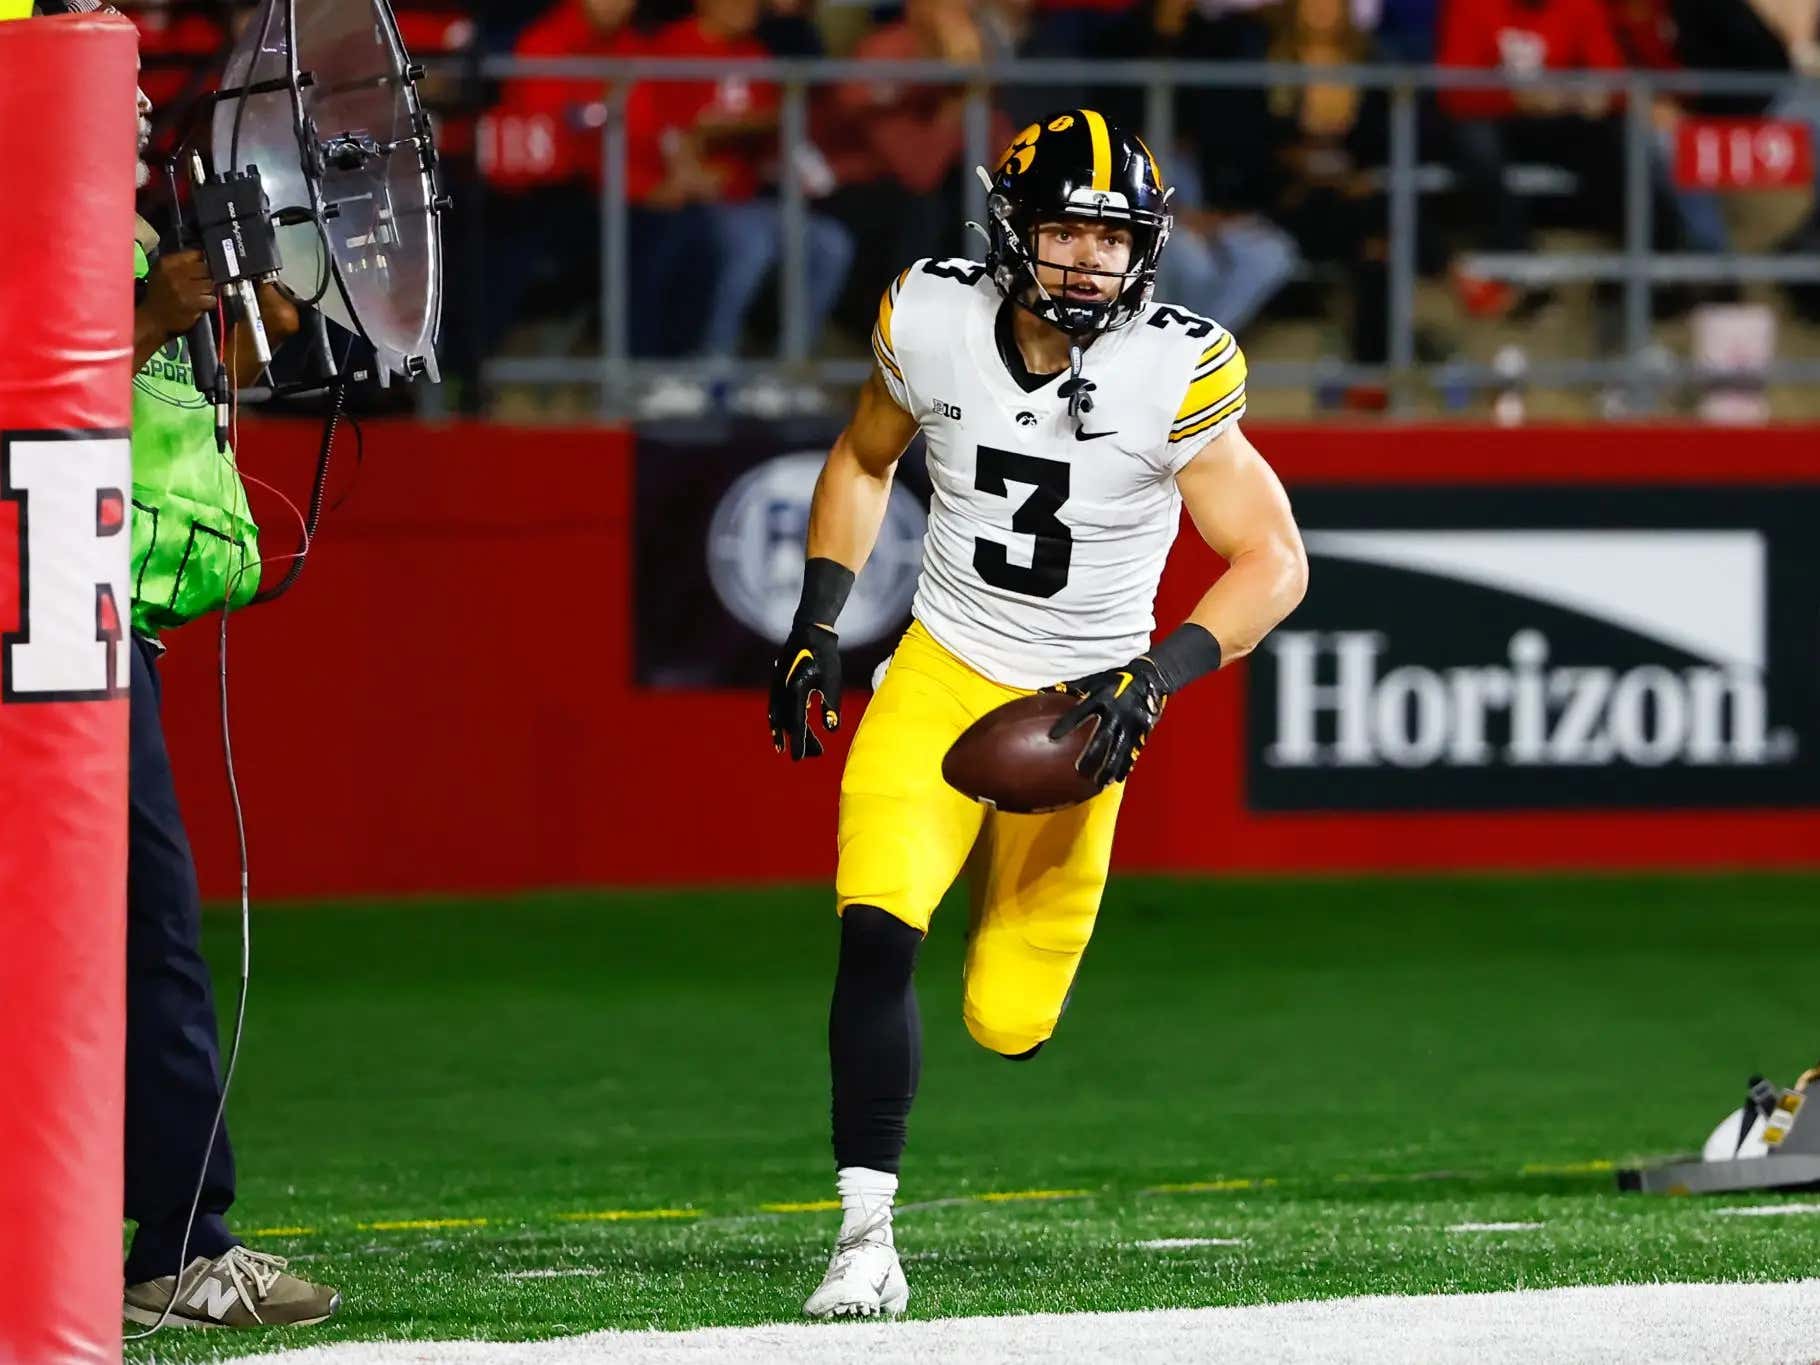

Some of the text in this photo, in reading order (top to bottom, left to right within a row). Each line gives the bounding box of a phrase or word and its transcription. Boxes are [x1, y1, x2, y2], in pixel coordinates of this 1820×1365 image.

[1147, 305, 1215, 339] 3
[972, 444, 1073, 599] 3
[1266, 629, 1769, 767] Horizon
